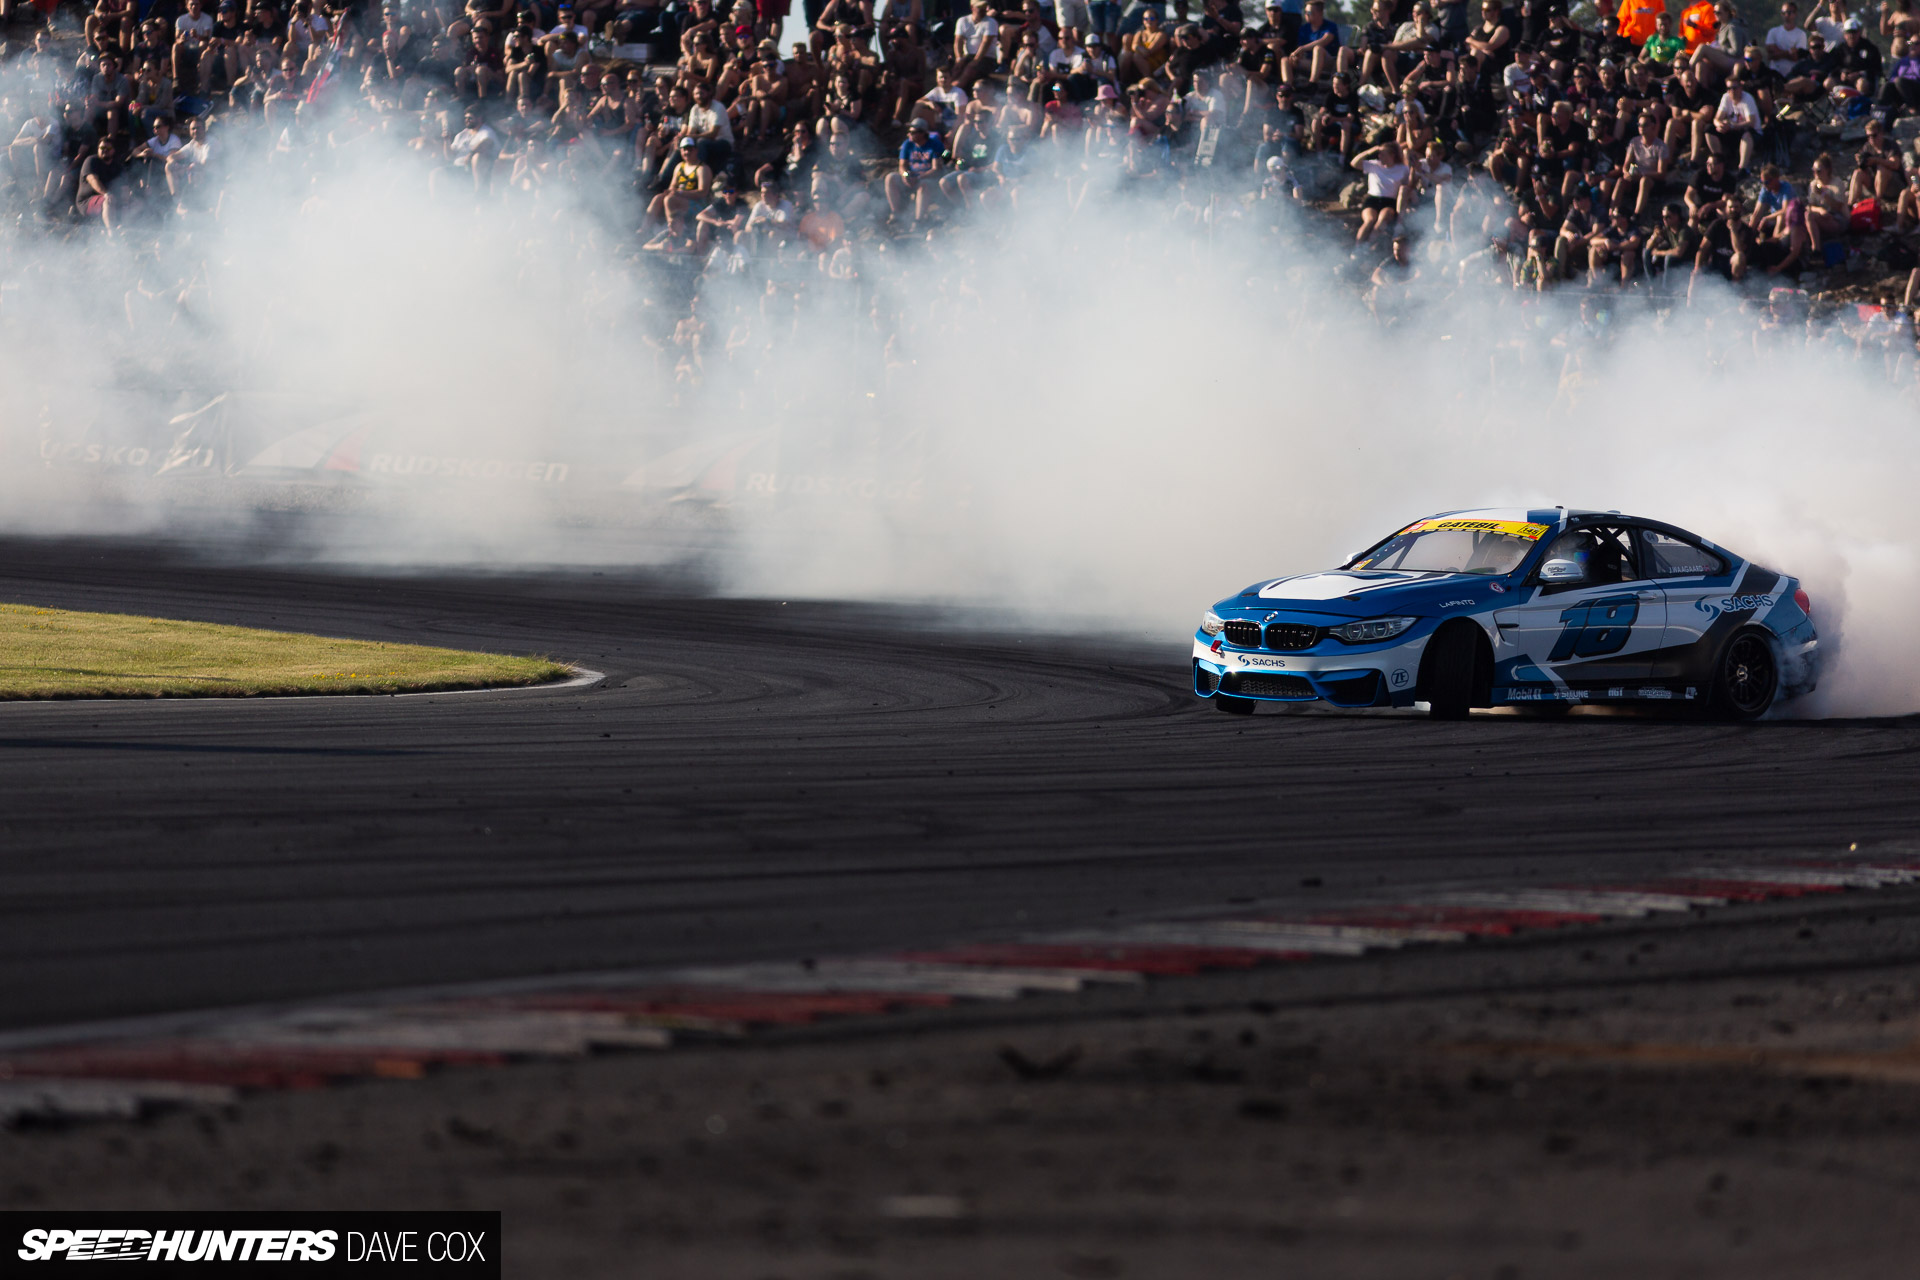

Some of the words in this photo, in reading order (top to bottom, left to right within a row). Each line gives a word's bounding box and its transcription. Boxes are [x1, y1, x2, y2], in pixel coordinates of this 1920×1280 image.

[369, 453, 569, 483] RUDSKOGEN
[1437, 521, 1500, 530] GATEBIL
[1720, 594, 1775, 613] SACHS
[1546, 593, 1640, 662] 18
[1252, 657, 1286, 668] SACHS
